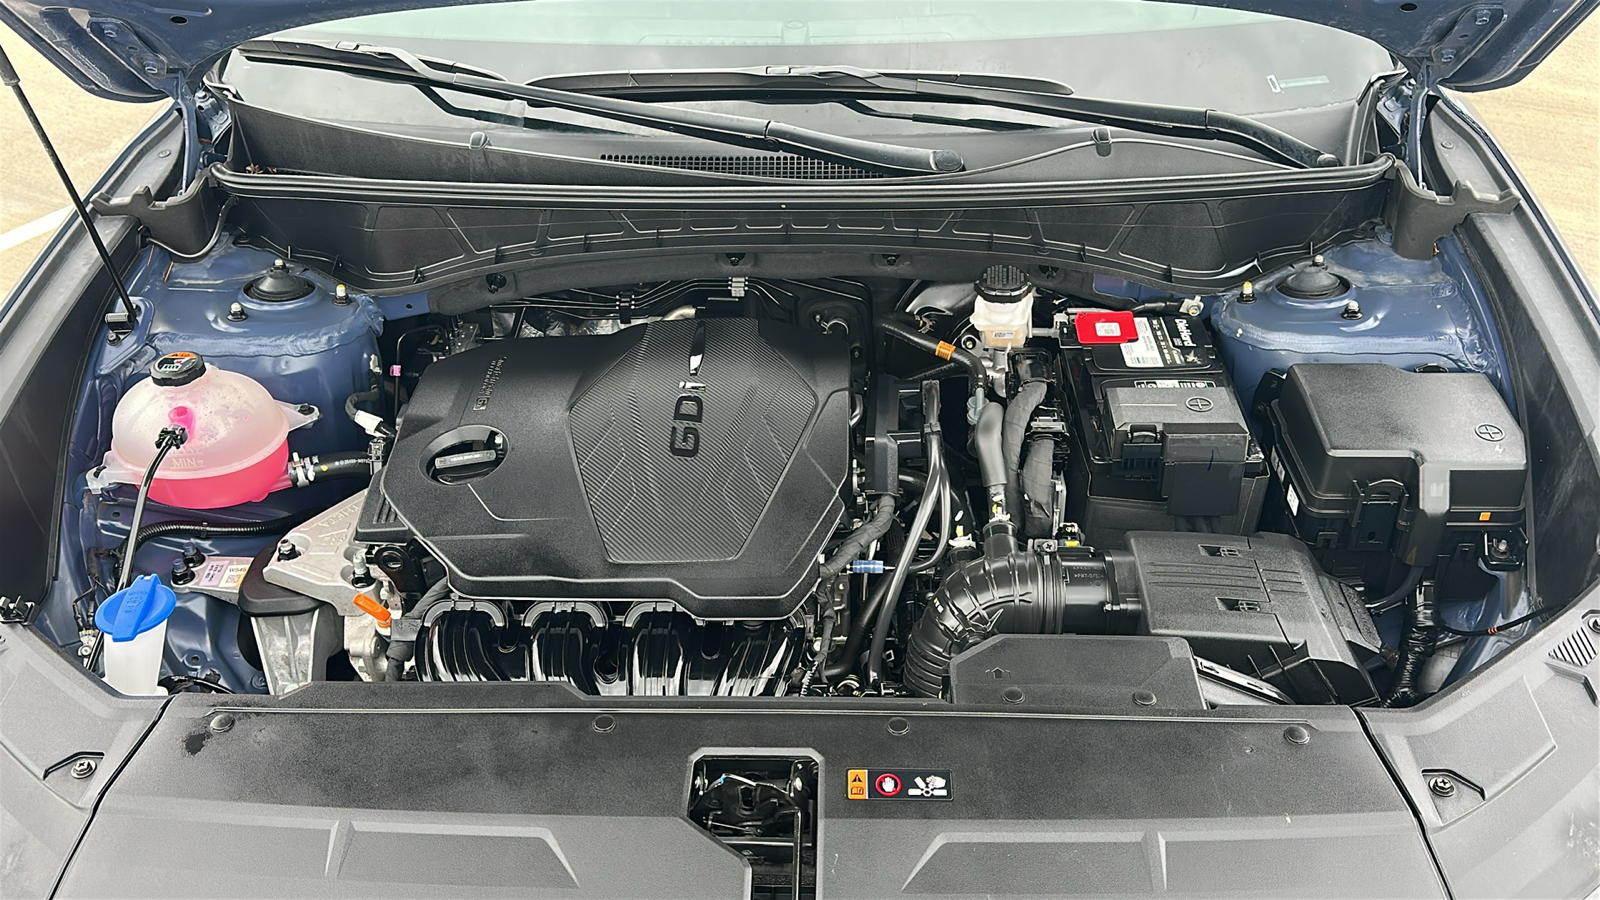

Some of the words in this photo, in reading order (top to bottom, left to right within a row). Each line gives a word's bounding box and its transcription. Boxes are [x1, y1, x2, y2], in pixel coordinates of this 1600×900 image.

[1174, 318, 1197, 347] DieHard
[669, 381, 706, 458] GDi
[172, 457, 197, 468] MIN
